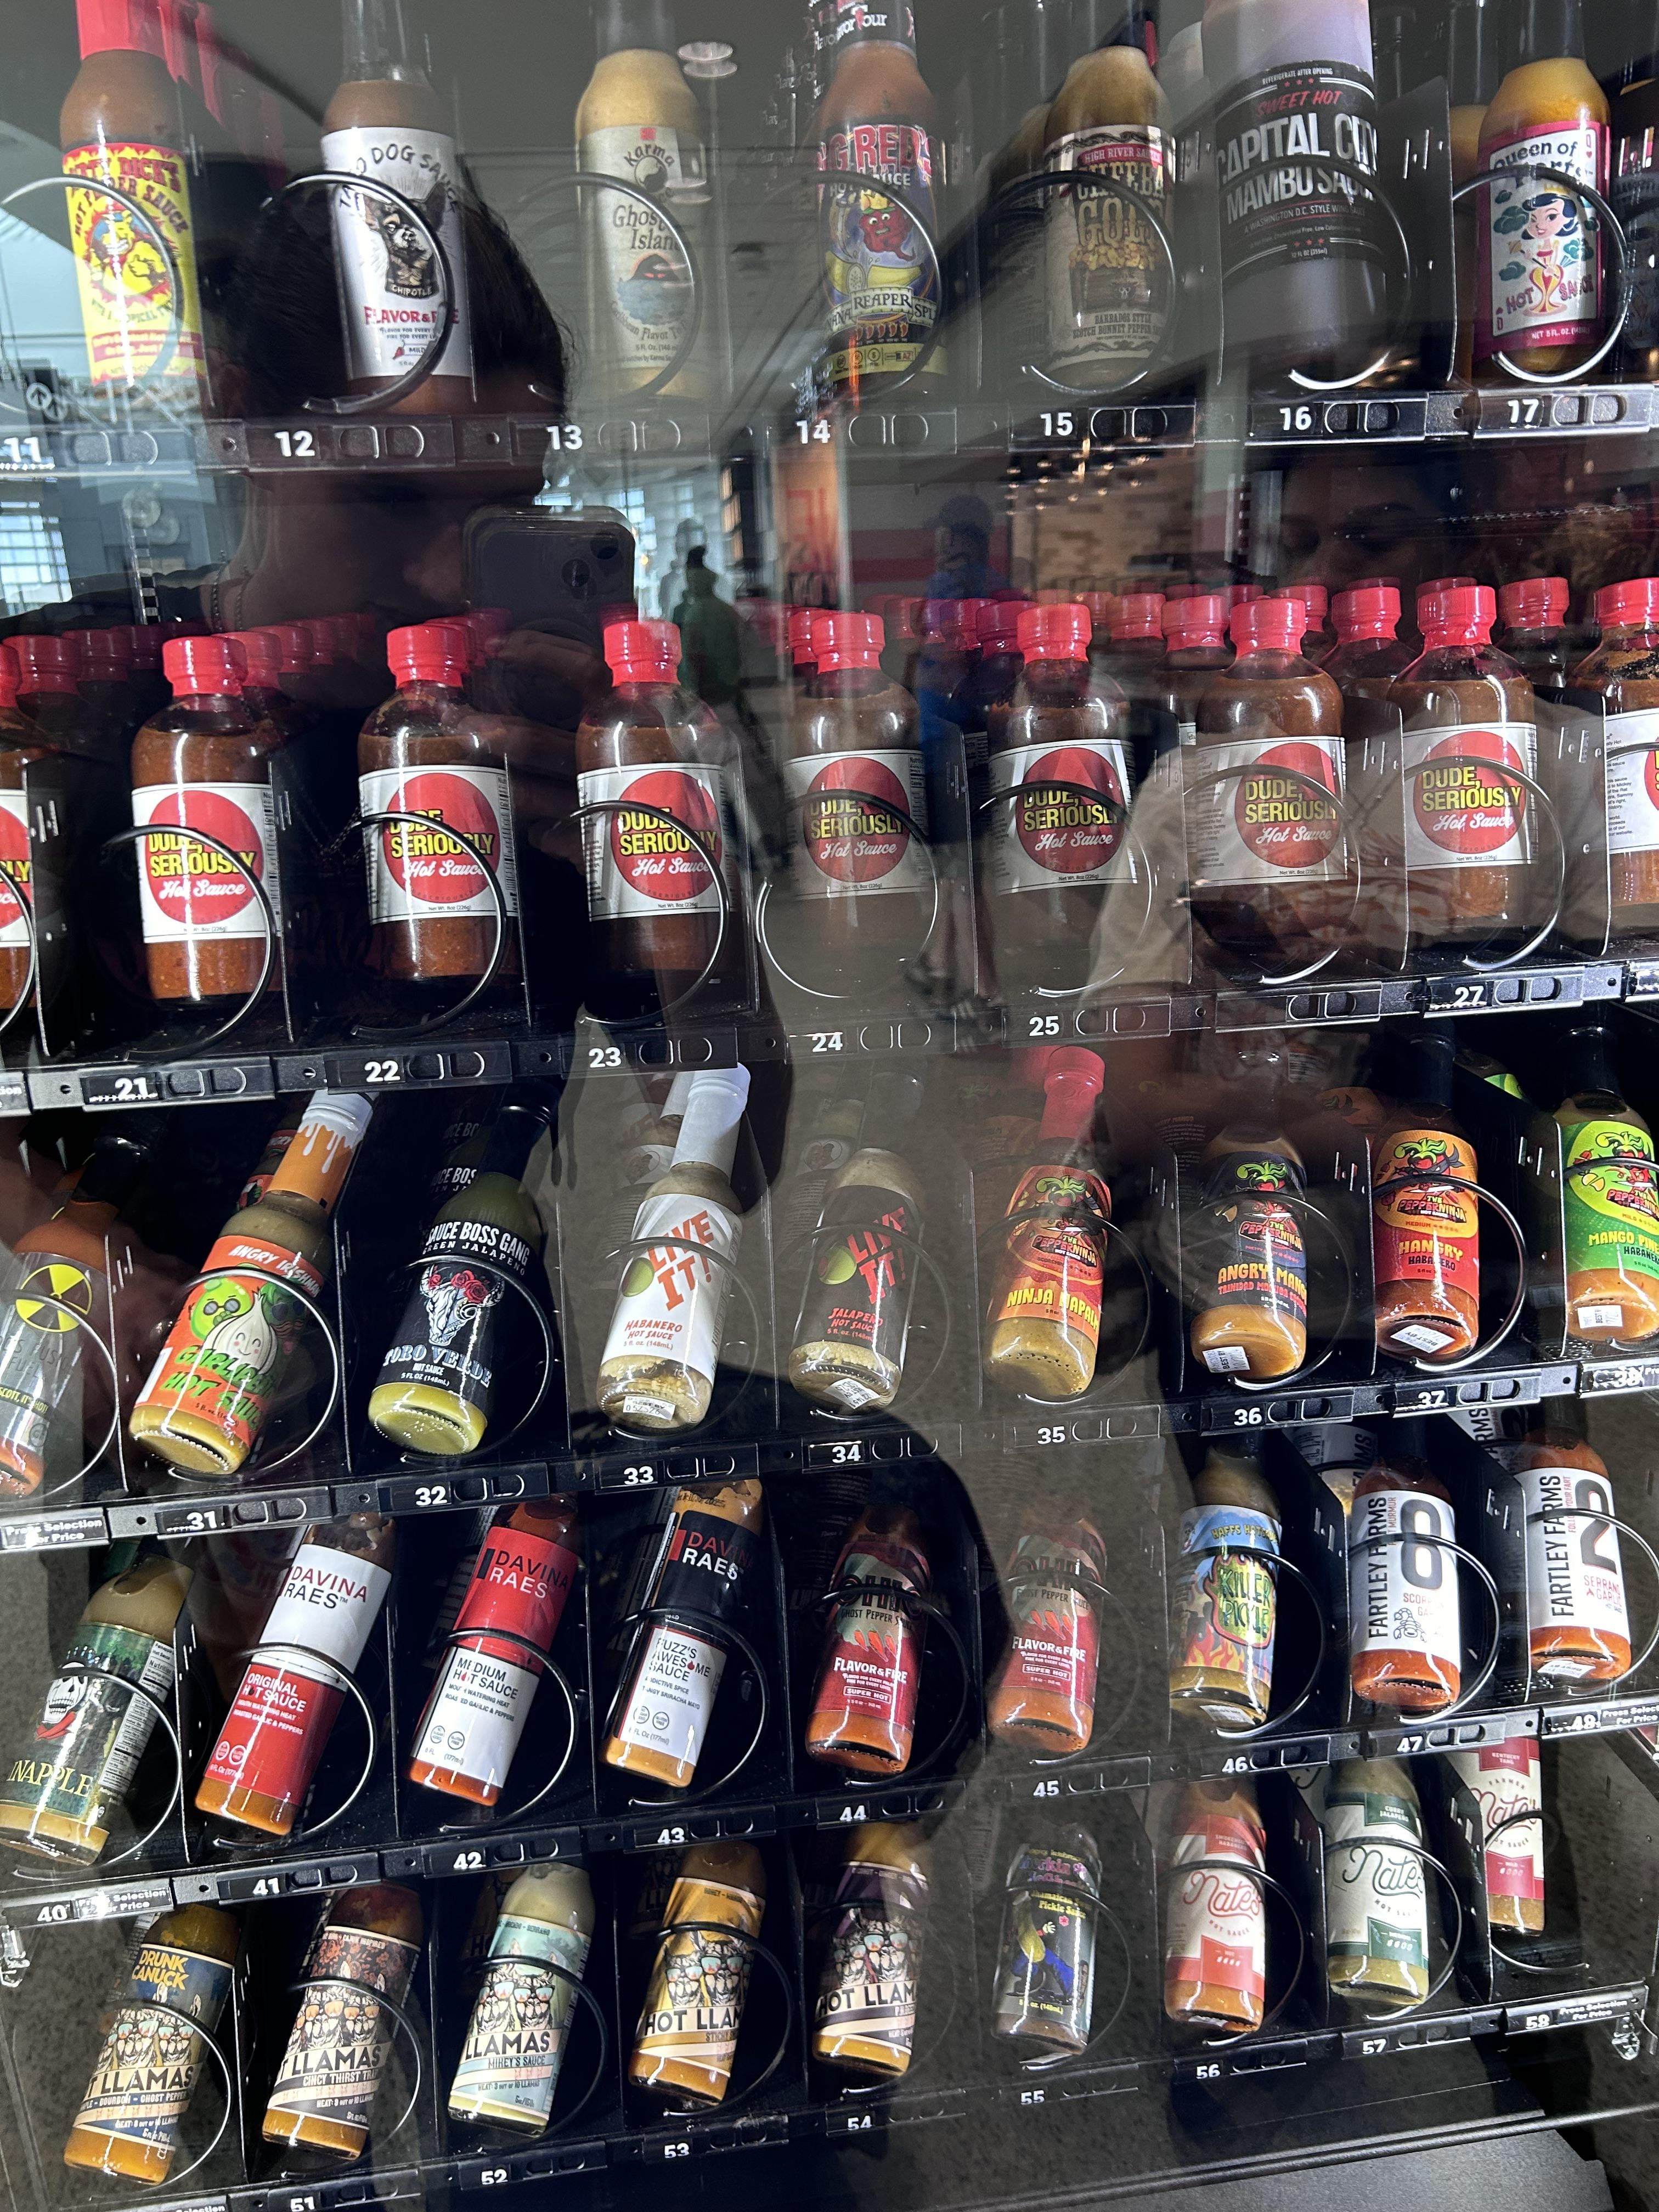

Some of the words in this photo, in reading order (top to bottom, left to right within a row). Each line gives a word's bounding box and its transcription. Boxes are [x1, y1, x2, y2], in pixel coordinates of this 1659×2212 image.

[1297, 68, 1312, 76] AFTER
[1256, 91, 1311, 117] SWEET
[1312, 90, 1343, 106] HOT
[371, 143, 414, 165] DOG
[623, 143, 675, 167] Karma
[1085, 152, 1105, 163] HIGH
[1107, 148, 1132, 160] RIVER
[1217, 112, 1330, 185] CAPITAL
[1556, 142, 1578, 158] of
[1226, 165, 1313, 225] MAMBO
[142, 183, 189, 235] SAUCE
[1310, 205, 1330, 213] STYLE
[391, 283, 433, 297] CHIPOTLE
[853, 292, 913, 310] REAPER
[1505, 287, 1534, 313] HOT
[641, 327, 669, 342] Flavor
[1097, 324, 1126, 336] BONNET
[1279, 406, 1312, 431] 16
[1508, 399, 1539, 428] 17
[795, 419, 831, 444] 14
[1041, 413, 1074, 437] 15
[275, 430, 316, 458] 12
[548, 426, 583, 451] 13
[5, 436, 42, 463] 11
[1420, 765, 1482, 791] DUDE,
[1244, 778, 1304, 803] DUDE,
[1421, 785, 1523, 812] SERIOUSLY
[1432, 814, 1466, 832] Hot
[1469, 812, 1515, 830] Sauce
[1035, 832, 1066, 852] Hot
[1069, 829, 1114, 847] Sauce
[1255, 826, 1290, 845] Hot
[1292, 824, 1332, 842] Sauce
[820, 842, 850, 861] Hot
[853, 839, 898, 857] Sauce
[404, 860, 436, 878] Hot
[631, 858, 665, 879] Hot
[195, 879, 248, 898] Sauce
[1454, 985, 1485, 1006] 27
[1028, 1015, 1061, 1037] 25
[811, 1033, 843, 1053] 24
[588, 1047, 622, 1069] 23
[364, 1060, 401, 1083] 22
[114, 1077, 149, 1101] 21
[424, 1221, 461, 1246] SAUCE
[461, 1221, 499, 1248] BOSS
[498, 1232, 531, 1267] GANG
[646, 1209, 715, 1273] LIVE
[1588, 1231, 1635, 1247] MANGO
[228, 1243, 277, 1266] ANGRY
[1399, 1240, 1464, 1263] HANGRY
[1217, 1263, 1268, 1284] ANGRY
[1006, 1287, 1055, 1310] NINJA
[623, 1318, 684, 1334] HABANERO
[830, 1318, 848, 1329] HOT
[627, 1329, 644, 1340] HOT
[645, 1331, 675, 1342] SAUCE
[645, 1340, 674, 1352] (148mL)
[382, 1344, 428, 1368] TORO
[431, 1347, 494, 1390] VERDE
[159, 1370, 222, 1399] HOT
[1417, 1391, 1446, 1408] 37
[1234, 1408, 1263, 1427] 36
[1036, 1426, 1066, 1446] 35
[832, 1445, 862, 1463] 34
[623, 1466, 654, 1486] 33
[415, 1486, 449, 1507] 32
[44, 1517, 103, 1533] Selection
[185, 1511, 220, 1532] 31
[1574, 1479, 1618, 1575] 2
[54, 1532, 85, 1544] Price
[1211, 1525, 1242, 1540] HAFFS
[1400, 1499, 1443, 1591] 8
[495, 1549, 568, 1589] DAVINA
[681, 1548, 738, 1581] RAES
[289, 1565, 368, 1603] DAVINA
[489, 1566, 549, 1599] RAES
[1545, 1538, 1576, 1618] FARTLEY
[1583, 1574, 1621, 1595] SERRANO
[283, 1581, 340, 1610] RAES
[1041, 1589, 1069, 1602] PEPPER
[1368, 1560, 1389, 1639] FARTLEY
[1595, 1589, 1623, 1607] GARLIC
[865, 1607, 893, 1623] PEPPER
[457, 1656, 507, 1683] MEDIUM
[1025, 1665, 1049, 1675] SUPER
[1051, 1669, 1069, 1679] HOT
[247, 1672, 299, 1697] ORIGINAL
[477, 1675, 519, 1700] SAUCE
[674, 1684, 690, 1695] SPICE
[846, 1686, 871, 1697] SUPER
[873, 1692, 889, 1702] HOT
[263, 1689, 307, 1713] SAUCE
[496, 1697, 511, 1708] HEAT
[660, 1691, 687, 1705] SRIRACHA
[278, 1712, 297, 1722] HEAT
[1601, 1707, 1628, 1718] Press
[1616, 1716, 1632, 1726] For
[1633, 1713, 1659, 1724] Price
[275, 1723, 304, 1735] PEPPERS
[1572, 1714, 1596, 1731] 48
[1397, 1736, 1424, 1754] 47
[1221, 1757, 1249, 1774] 46
[1032, 1780, 1060, 1798] 45
[1488, 1774, 1527, 1790] FARMER
[839, 1805, 867, 1822] 44
[657, 1827, 687, 1845] 43
[1507, 1837, 1530, 1849] SAUCE
[453, 1852, 483, 1869] 42
[112, 1888, 167, 1903] Selection
[252, 1877, 281, 1895] 41
[37, 1905, 68, 1922] 40
[119, 1899, 150, 1910] Price
[1038, 1900, 1062, 1912] Pickle
[1374, 1898, 1392, 1911] HOT
[1226, 1927, 1251, 1937] SAUCE
[138, 1949, 189, 1973] DRUNK
[132, 1964, 189, 1991] CANUCK
[819, 1988, 856, 2019] HOT
[1559, 2005, 1584, 2016] Press
[1585, 1997, 1629, 2009] Selection
[644, 2009, 689, 2036] HOT
[1525, 2014, 1550, 2030] 58
[1572, 2009, 1587, 2021] For
[1588, 2007, 1613, 2018] Price
[465, 2030, 550, 2061] LLAMAS
[1362, 2039, 1387, 2055] 57
[291, 2045, 382, 2078] LLAMAS
[523, 2056, 546, 2067] SAUCE
[100, 2064, 194, 2096] LLAMAS
[302, 2074, 328, 2087] CINCY
[329, 2073, 362, 2086] THIRST
[1195, 2064, 1221, 2080] 56
[140, 2092, 165, 2103] GHOST
[1019, 2090, 1045, 2105] 55
[847, 2115, 873, 2132] 54
[663, 2143, 690, 2159] 53
[480, 2169, 509, 2186] 52
[290, 2198, 316, 2212] 51
